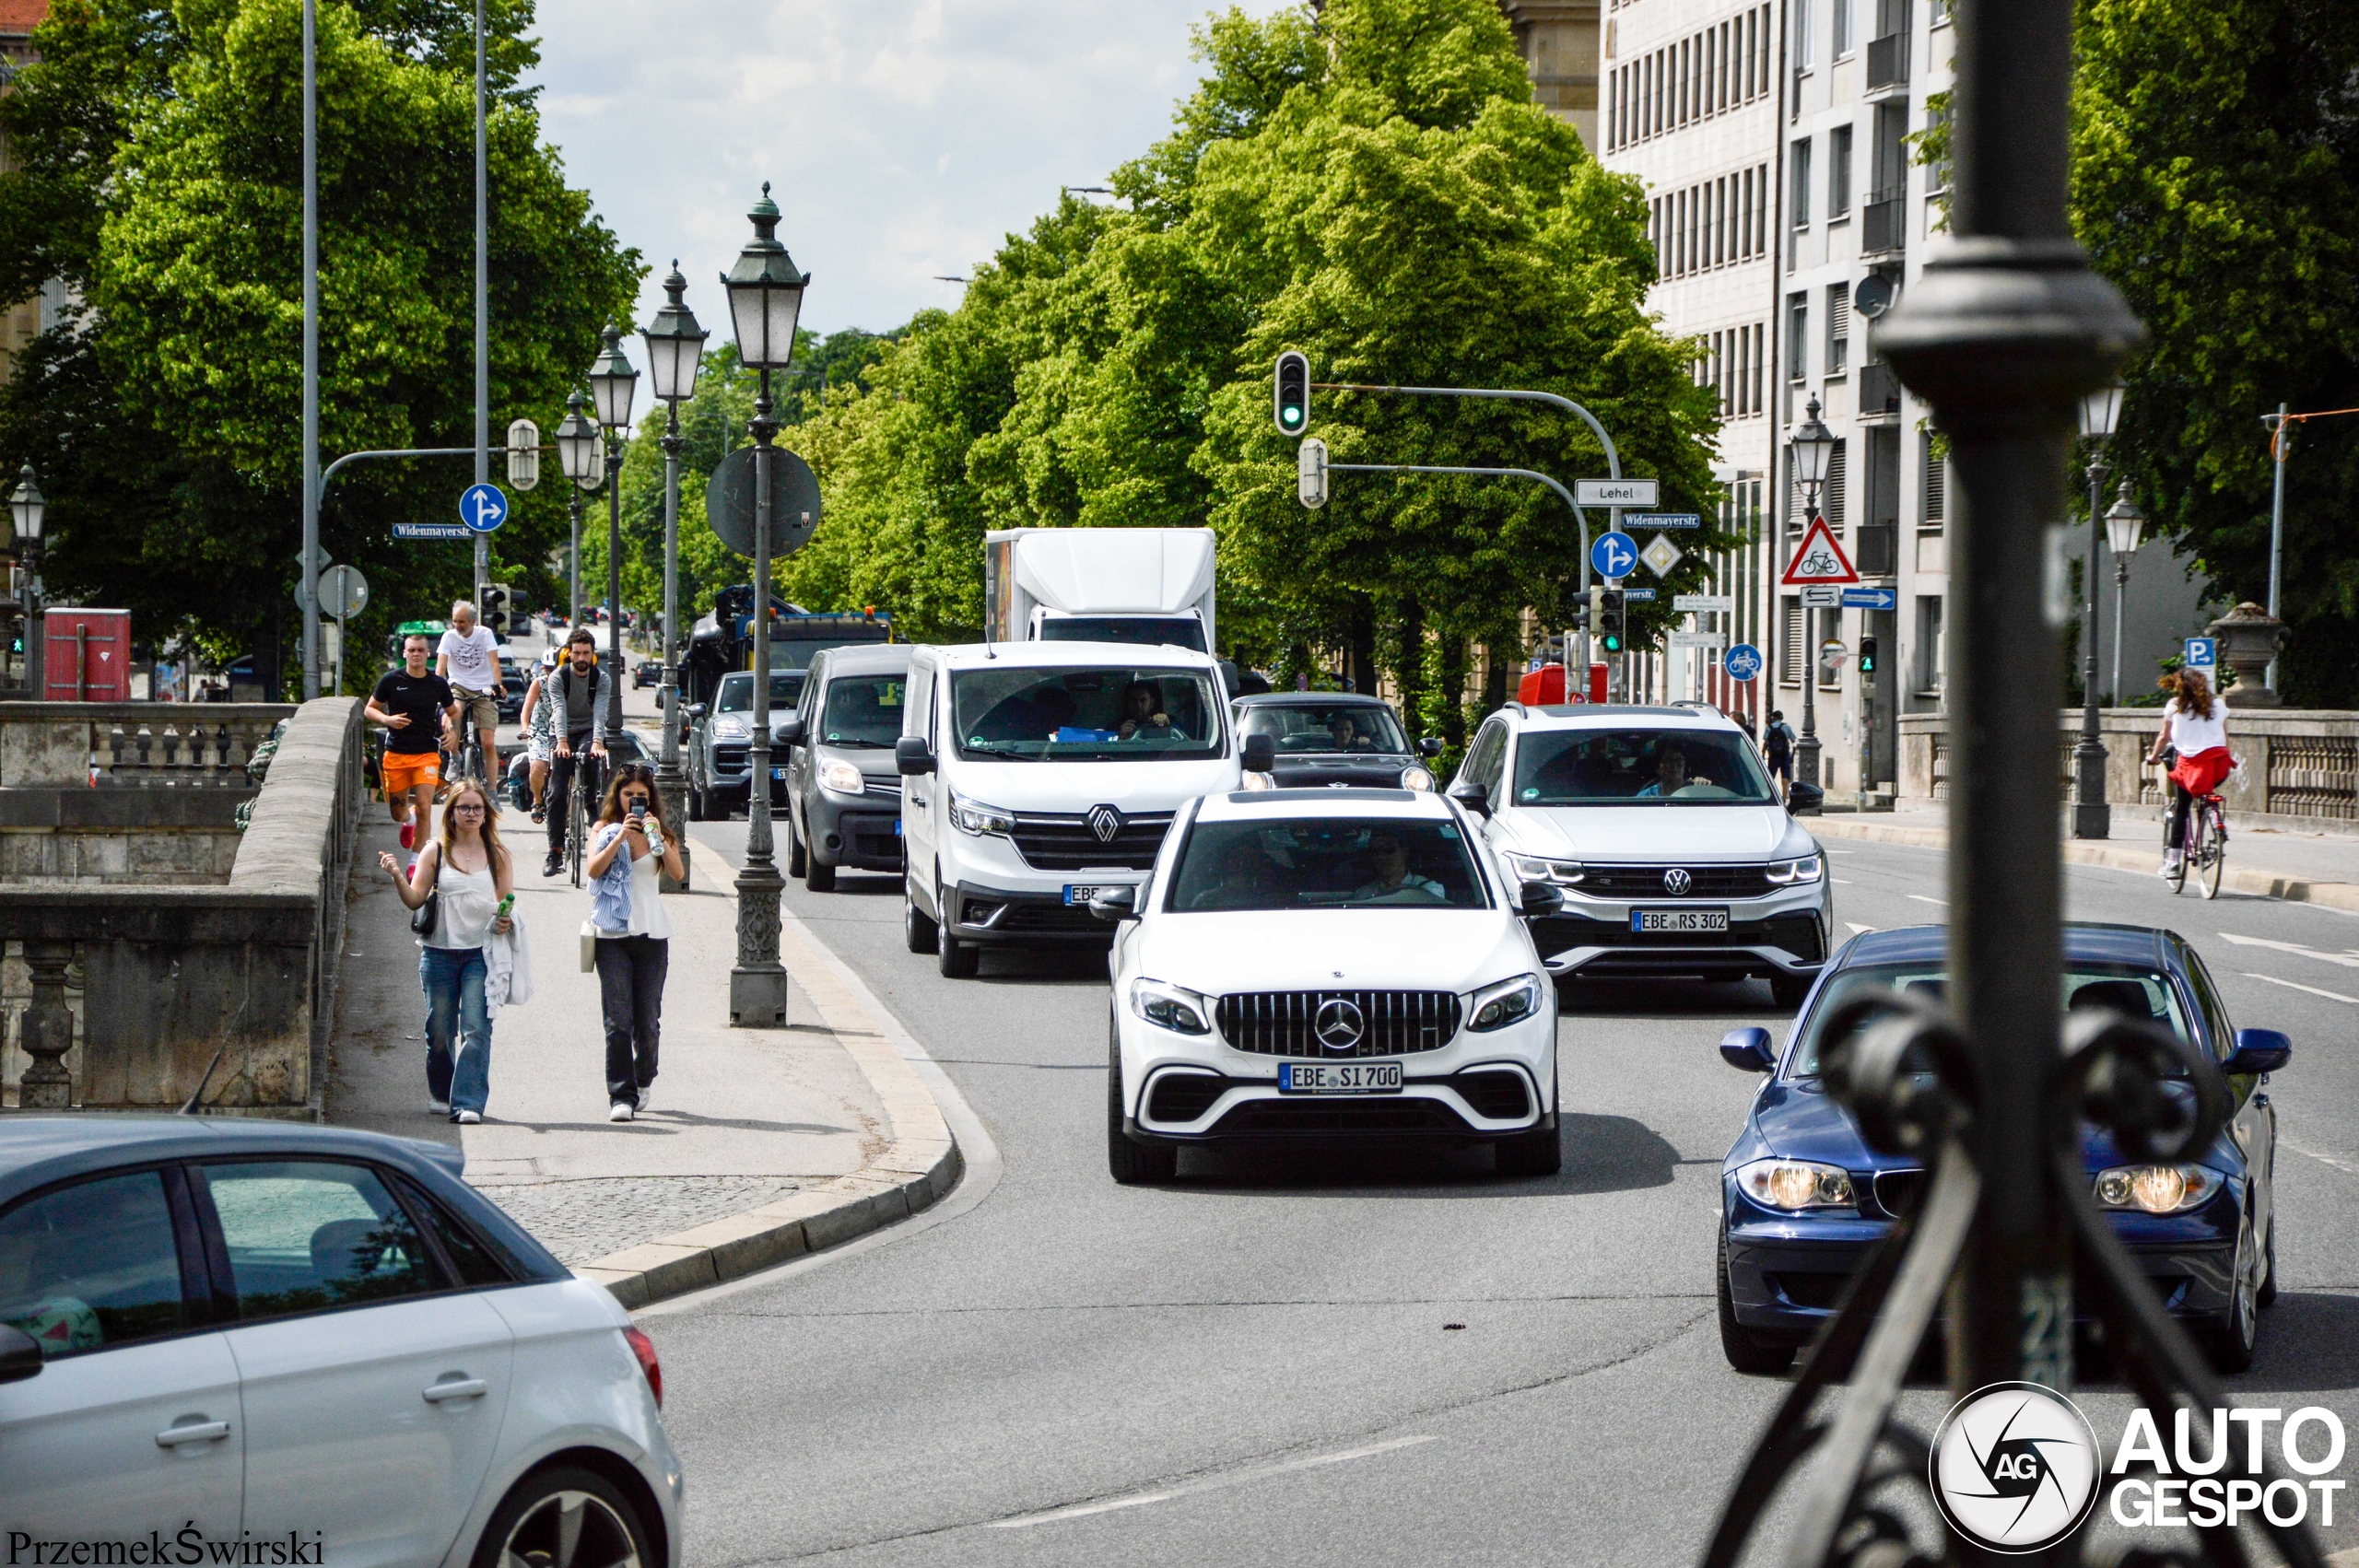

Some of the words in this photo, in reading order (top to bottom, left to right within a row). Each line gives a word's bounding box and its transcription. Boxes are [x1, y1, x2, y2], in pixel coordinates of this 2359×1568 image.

[1600, 487, 1634, 498] Lehel
[1625, 514, 1697, 528] Widenmayerstr.
[397, 525, 472, 537] Widenmayerstr.
[2189, 641, 2207, 663] P
[1532, 661, 1542, 673] P
[1642, 914, 1669, 929] EBE
[1679, 914, 1696, 929] RS
[1700, 914, 1726, 929] 302
[1292, 1068, 1326, 1086] EBE
[1340, 1067, 1362, 1087] SI
[1366, 1067, 1399, 1086] 700
